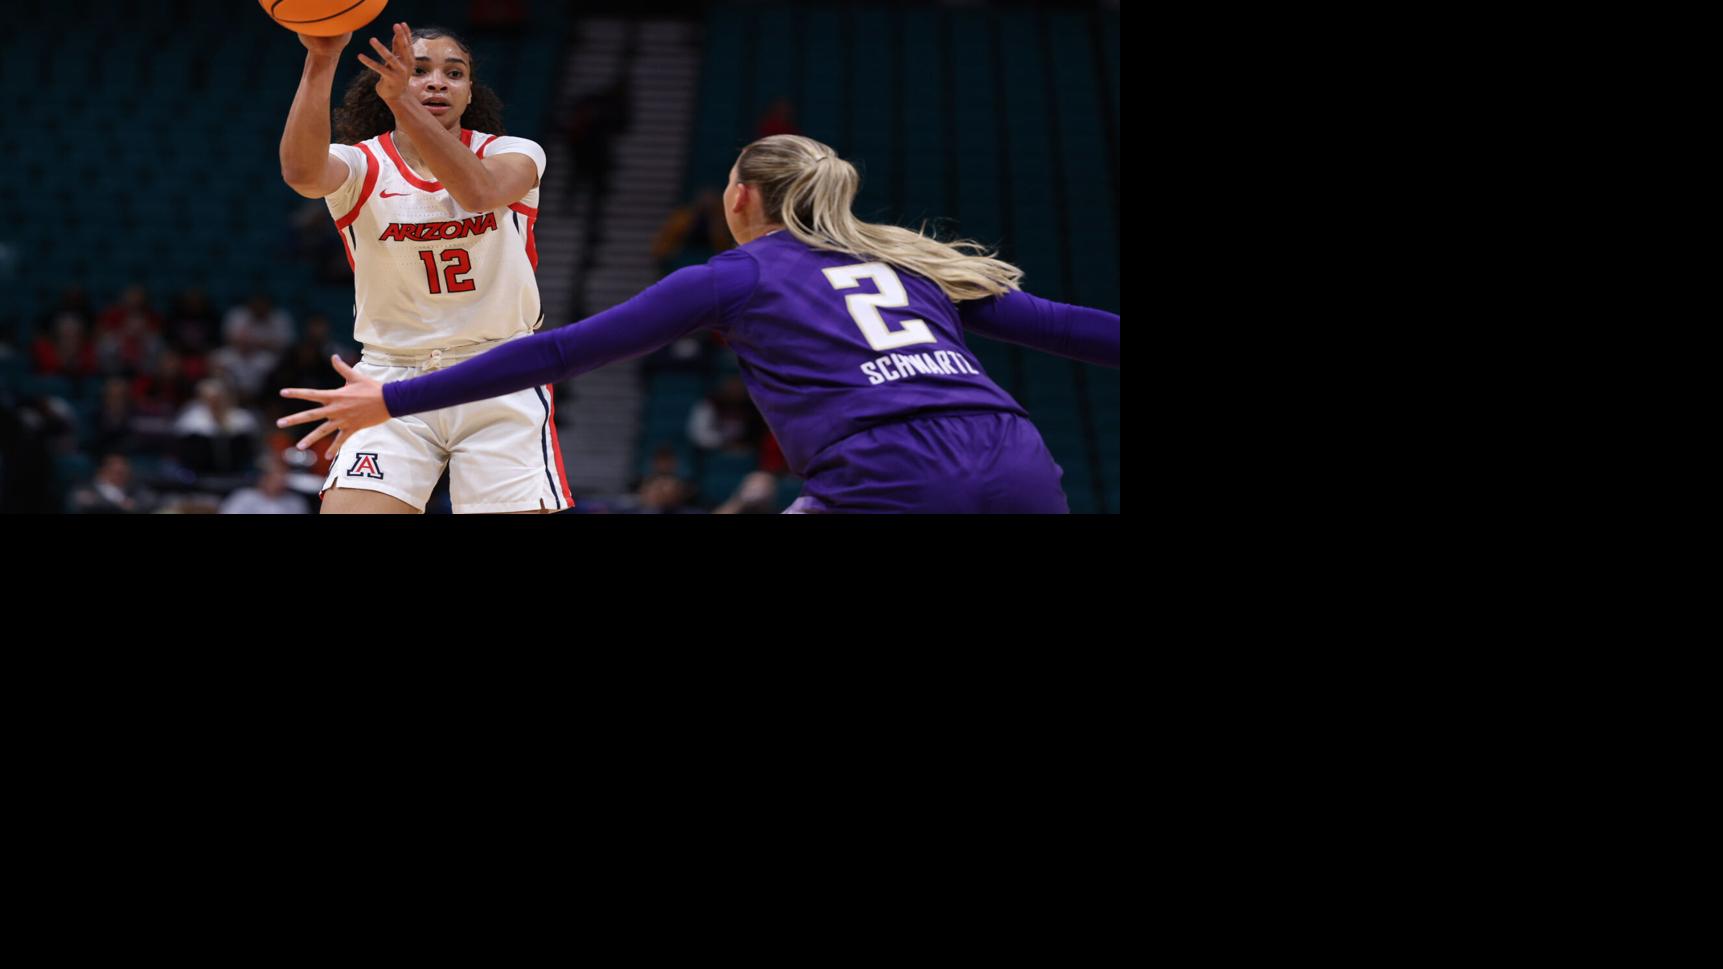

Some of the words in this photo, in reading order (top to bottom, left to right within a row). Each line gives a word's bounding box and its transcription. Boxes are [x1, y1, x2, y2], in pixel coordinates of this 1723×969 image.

[378, 211, 498, 242] ARIZONA
[418, 248, 476, 294] 12
[821, 261, 938, 351] 2
[347, 452, 384, 480] A
